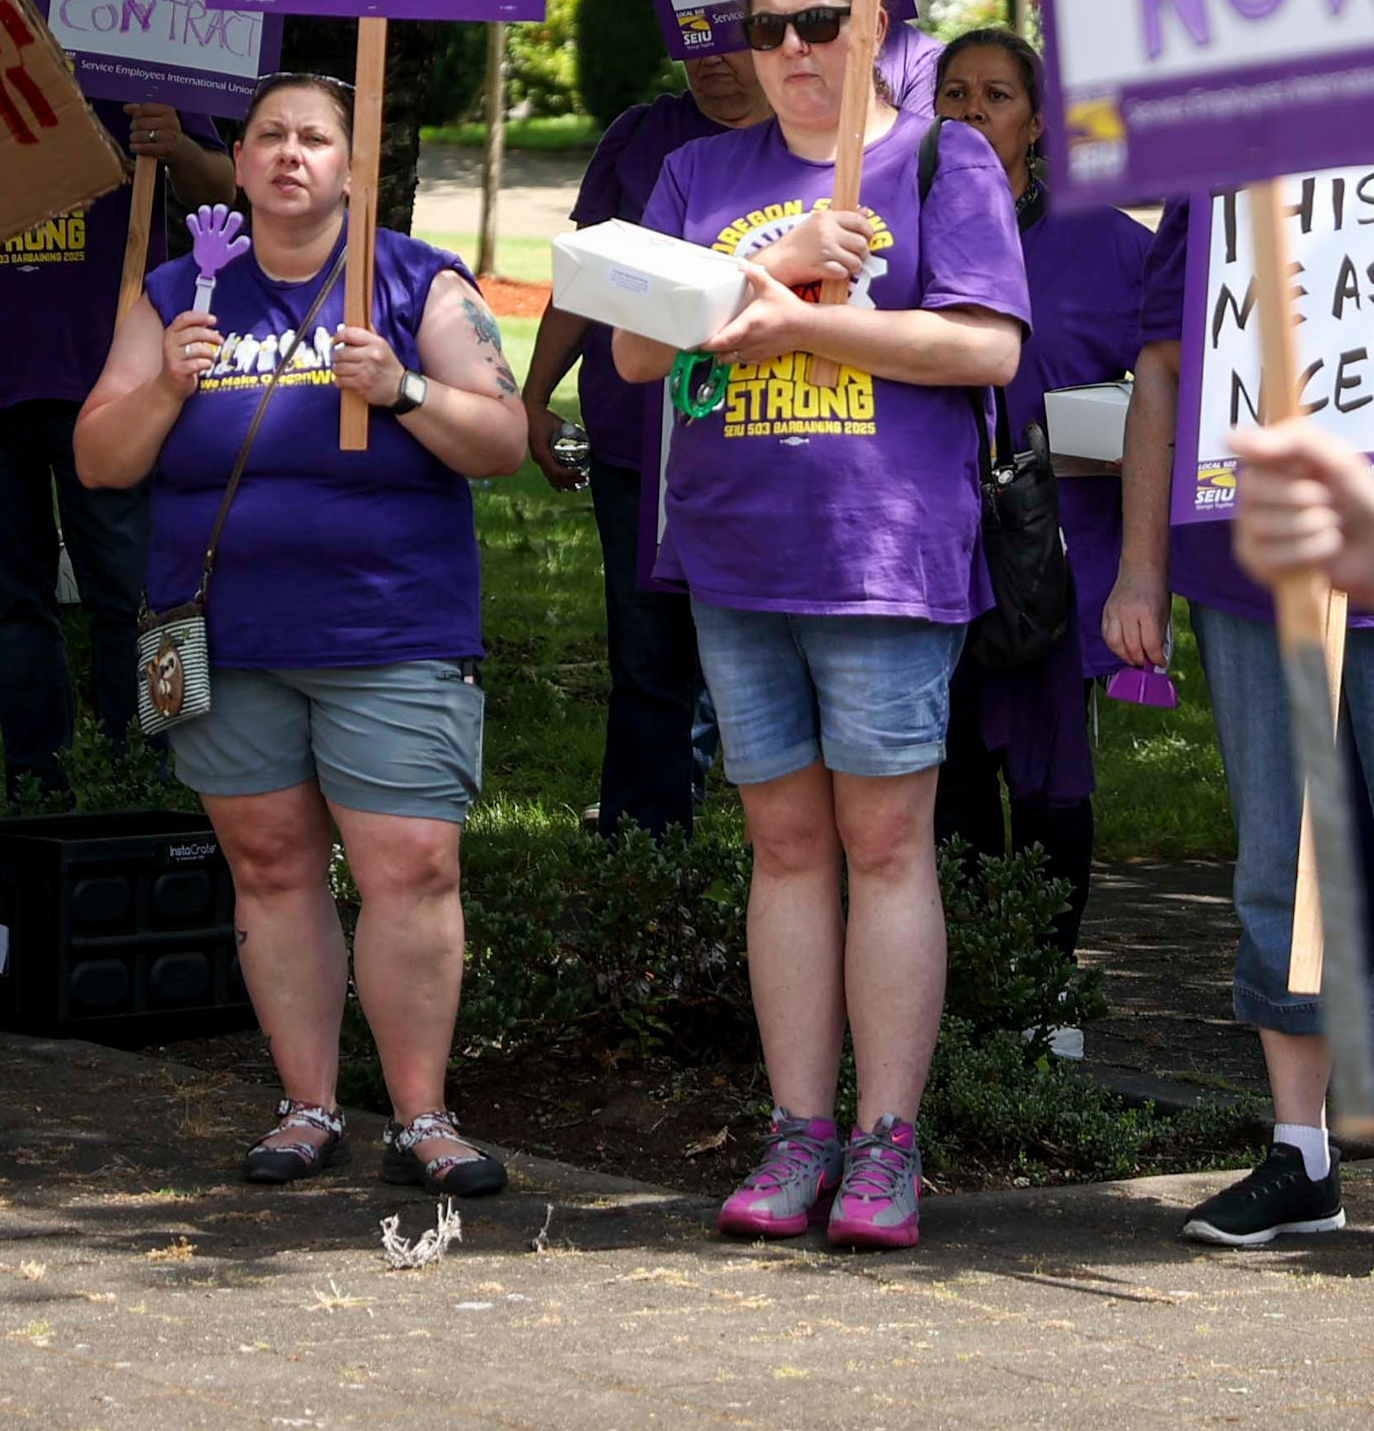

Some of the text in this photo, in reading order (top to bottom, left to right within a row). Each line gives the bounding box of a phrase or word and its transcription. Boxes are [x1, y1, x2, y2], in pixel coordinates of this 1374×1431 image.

[712, 12, 745, 24] Service
[683, 31, 712, 46] SEIU
[81, 59, 114, 74] Service
[115, 64, 165, 83] Employees
[167, 72, 226, 91] International
[11, 252, 62, 264] BARGAINING
[63, 251, 85, 262] 2025
[221, 374, 258, 387] Make
[260, 372, 312, 385] Oegon
[725, 380, 875, 423] STRONG
[724, 420, 877, 438] SEIU 503 BARGAINING 2025
[1195, 489, 1235, 504] SEIU
[169, 843, 215, 857] InstaCrate
